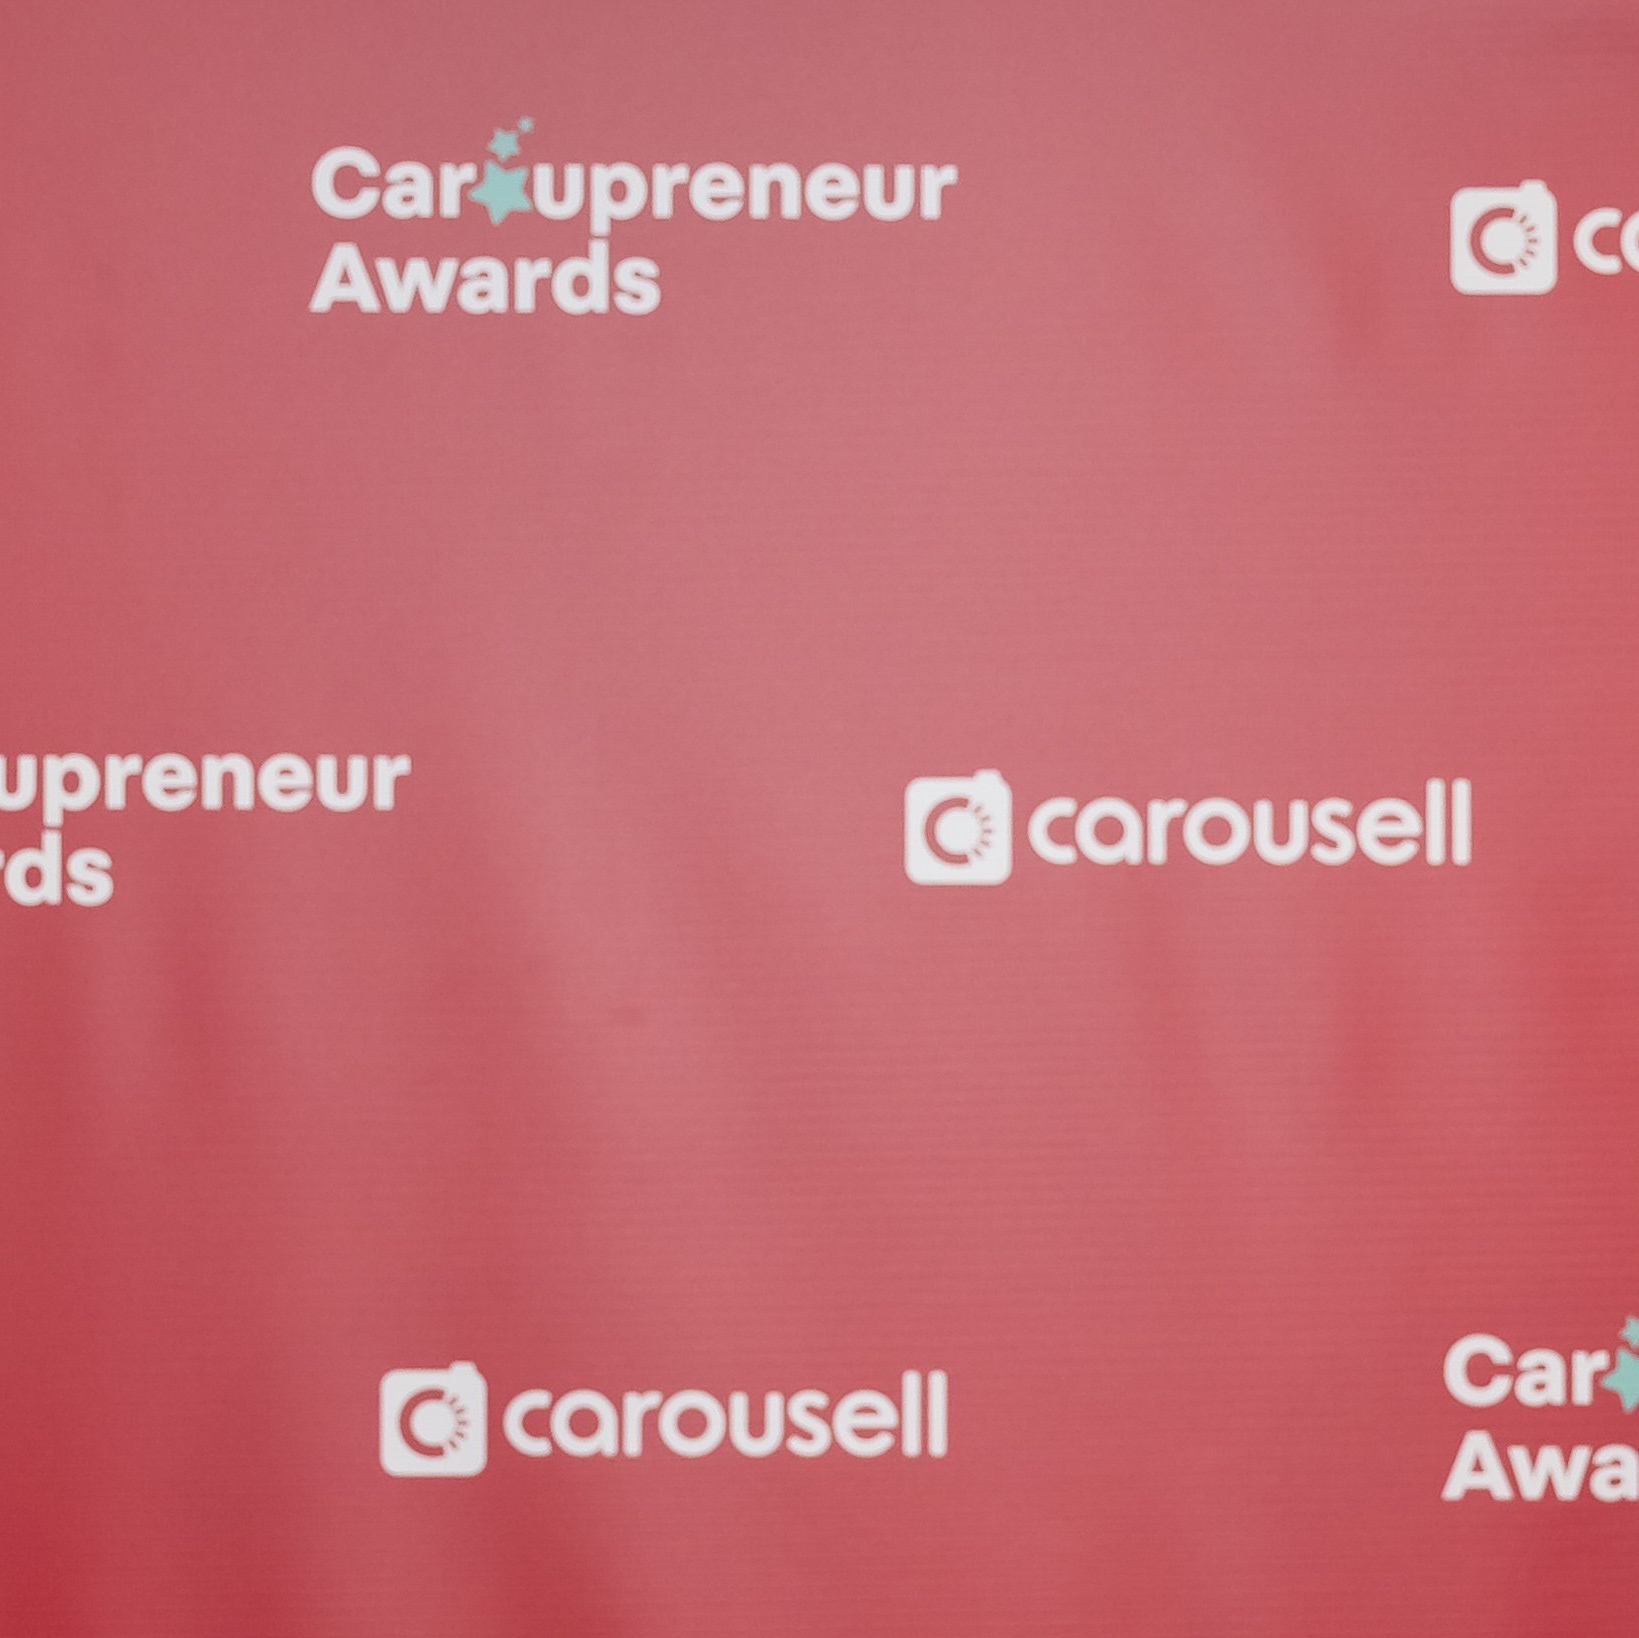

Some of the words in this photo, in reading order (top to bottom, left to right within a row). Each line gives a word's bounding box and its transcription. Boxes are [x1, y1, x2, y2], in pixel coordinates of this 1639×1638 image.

[306, 235, 664, 318] Awards
[1024, 775, 1475, 869] carousell
[501, 1367, 951, 1460] carousell
